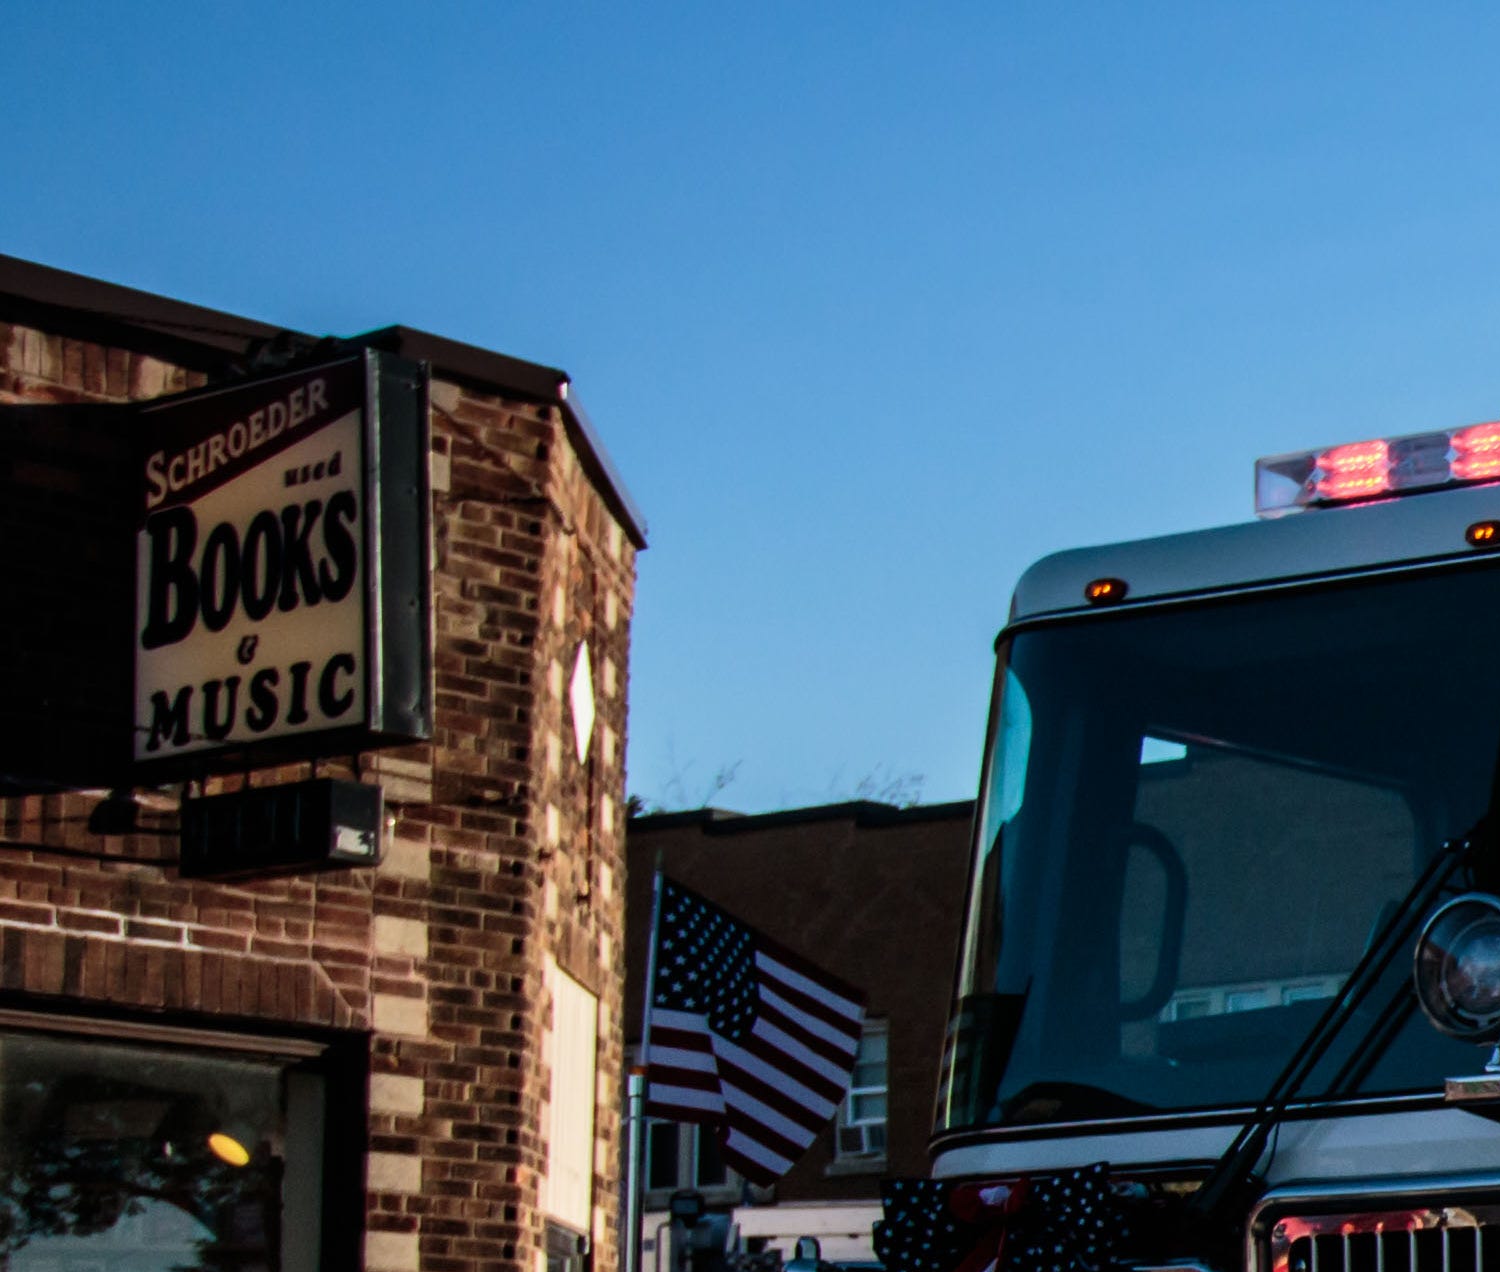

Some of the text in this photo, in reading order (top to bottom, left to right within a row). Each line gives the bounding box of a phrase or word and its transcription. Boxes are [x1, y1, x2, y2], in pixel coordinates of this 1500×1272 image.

[145, 378, 329, 508] SCHROEDER
[141, 490, 357, 650] BOOKS
[146, 653, 355, 750] MUSIC
